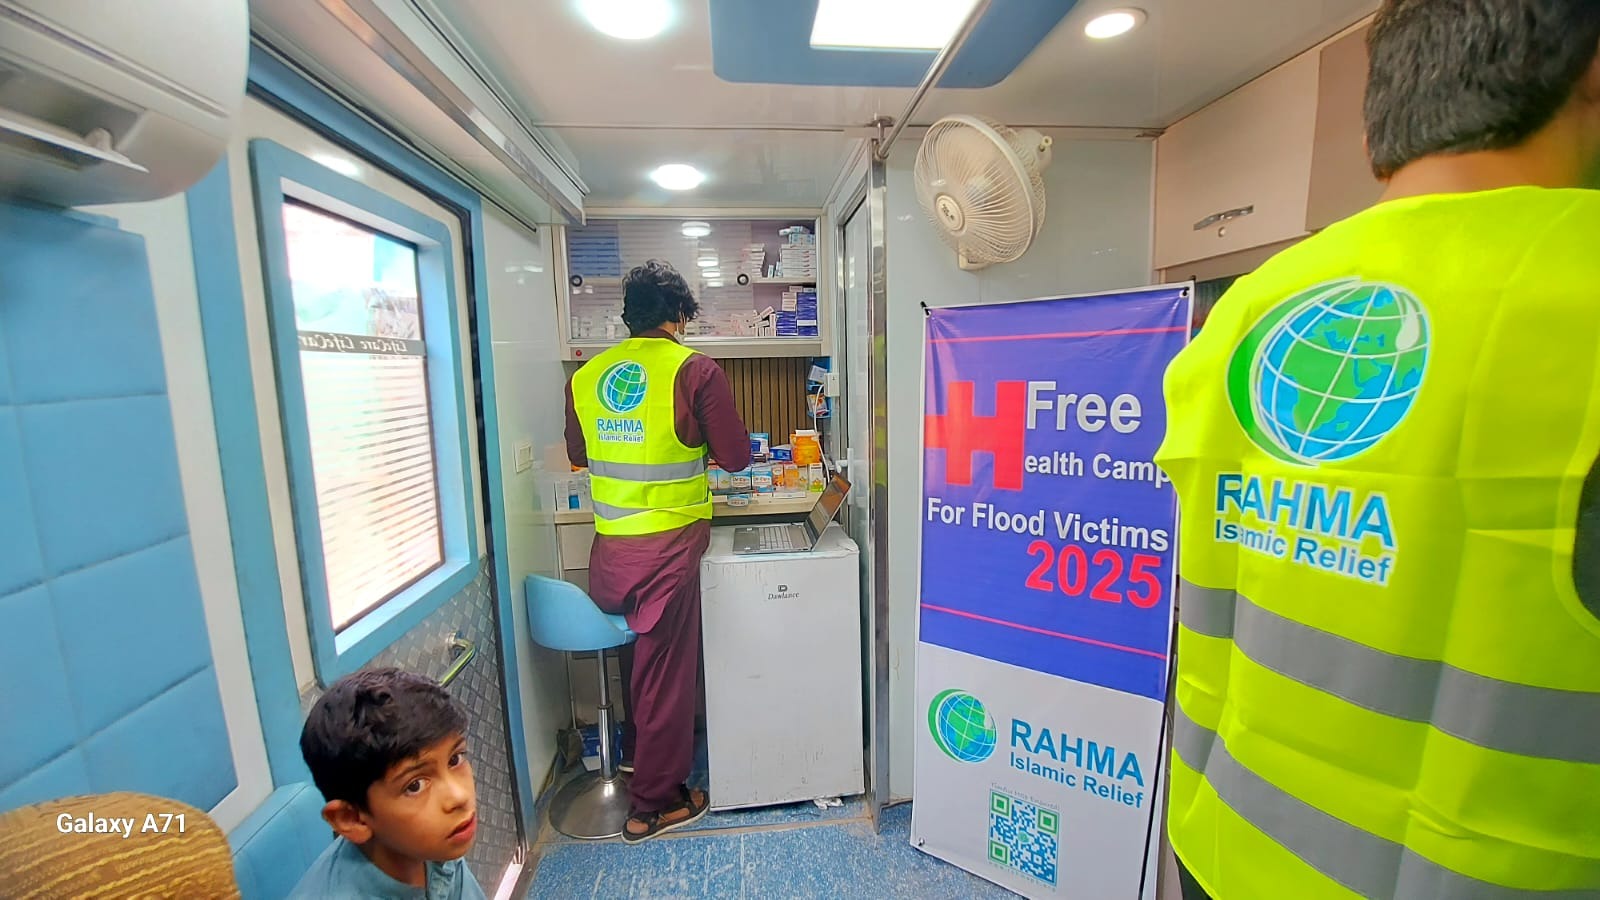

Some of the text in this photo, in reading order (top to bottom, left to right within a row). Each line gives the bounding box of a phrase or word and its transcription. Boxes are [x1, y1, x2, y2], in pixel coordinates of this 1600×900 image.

[597, 418, 644, 433] RAHMA
[1026, 380, 1142, 434] Free
[598, 433, 644, 443] Islamic Relief
[1093, 453, 1172, 489] Camp
[927, 497, 1169, 552] For Flood Victims
[1216, 474, 1394, 548] RAHMA
[1025, 540, 1162, 609] 2025
[1215, 519, 1392, 583] Ismic Relief
[1009, 752, 1077, 788] Islamic
[1083, 775, 1144, 809] Relief
[1010, 718, 1144, 788] RAHMA
